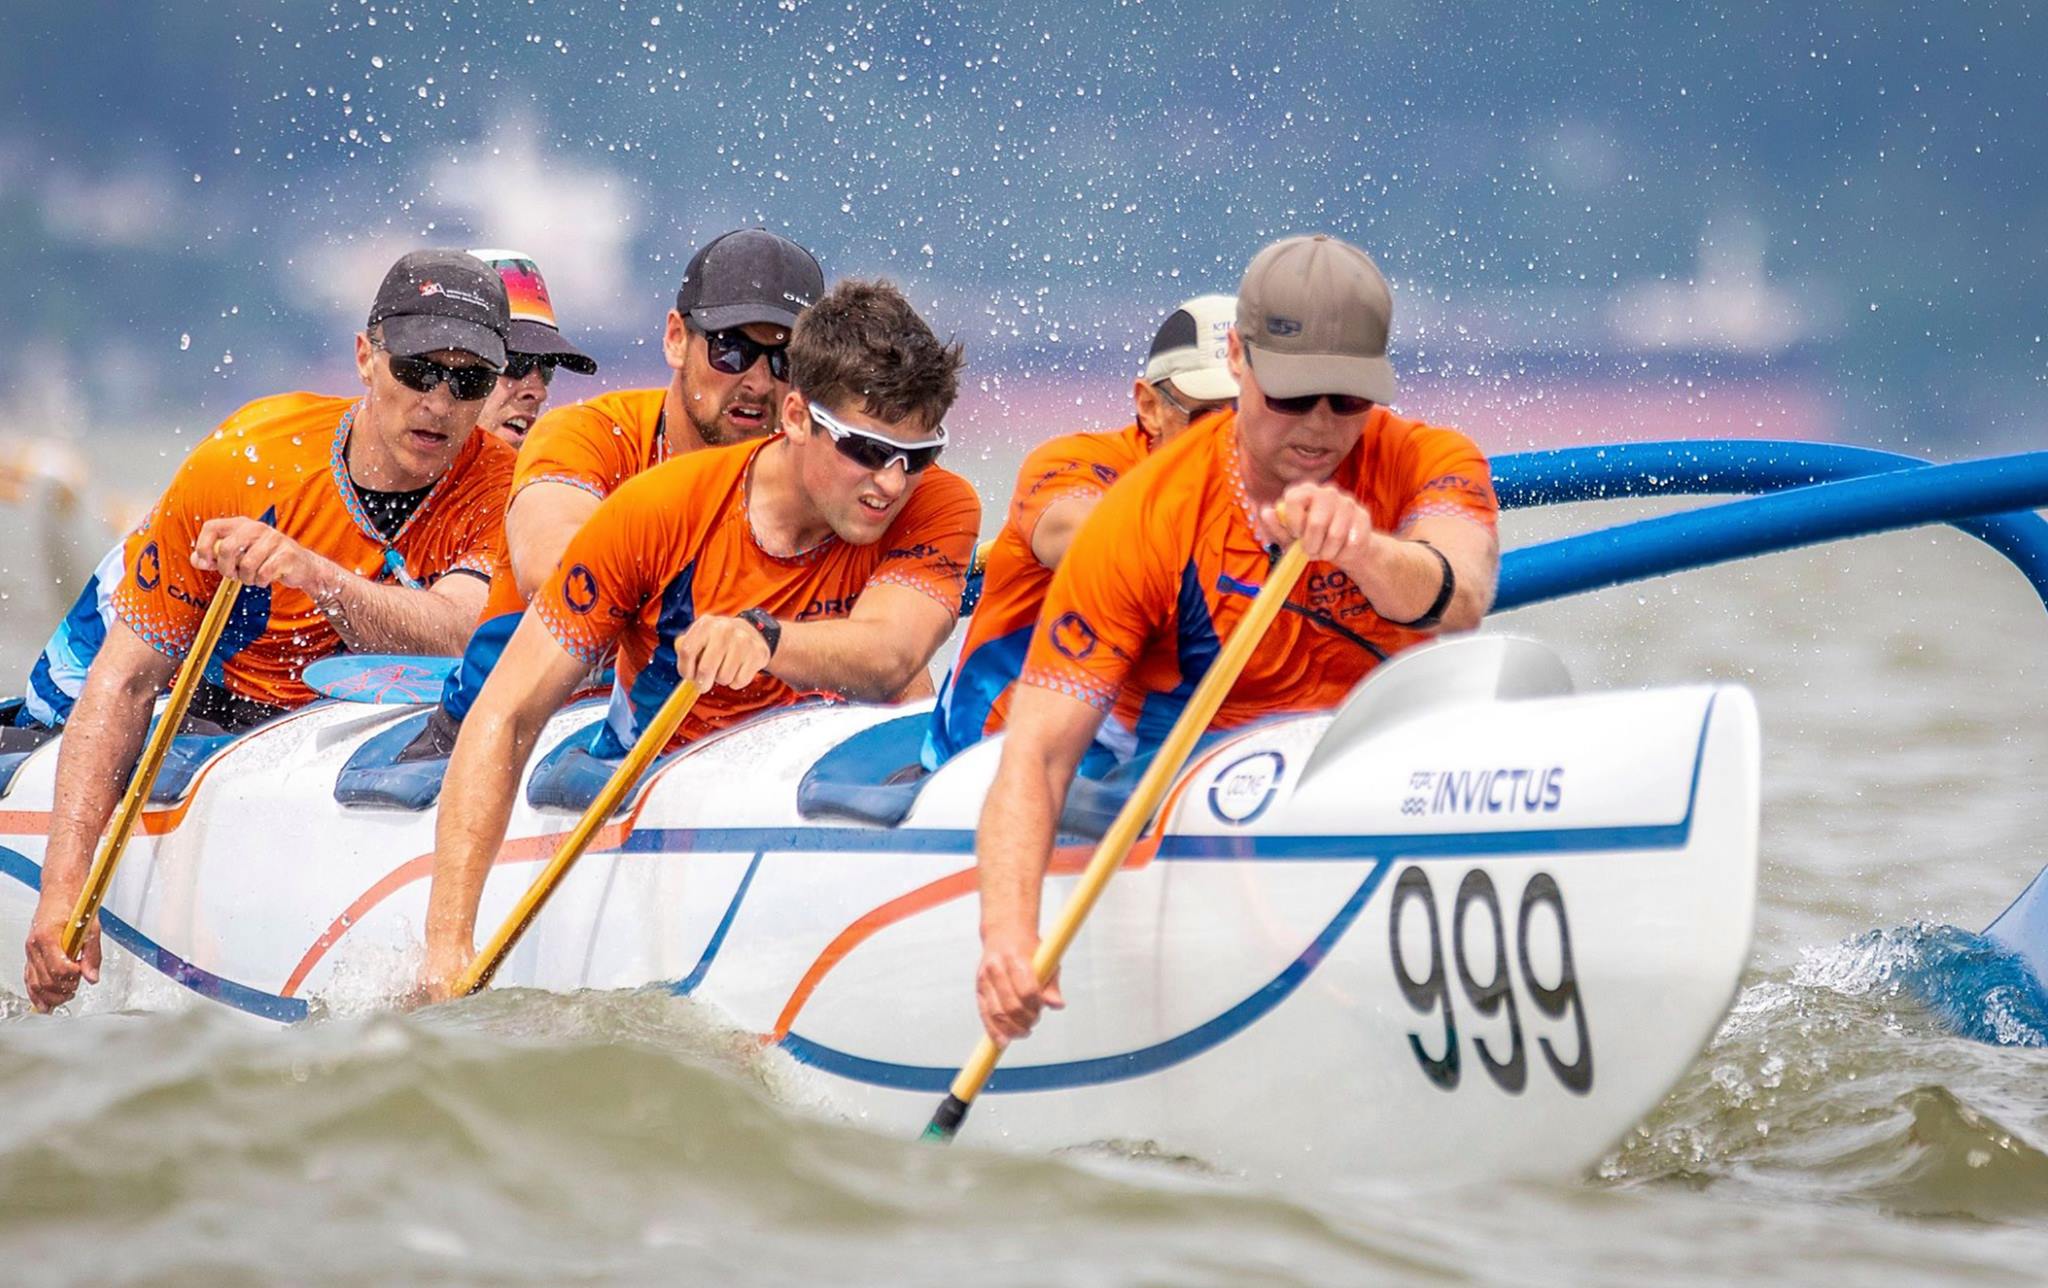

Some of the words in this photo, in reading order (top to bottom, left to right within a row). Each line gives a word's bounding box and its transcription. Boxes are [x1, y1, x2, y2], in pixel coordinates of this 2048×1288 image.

[167, 584, 211, 611] CAN
[1432, 766, 1565, 815] INVICTUS
[1388, 864, 1595, 1098] 999
